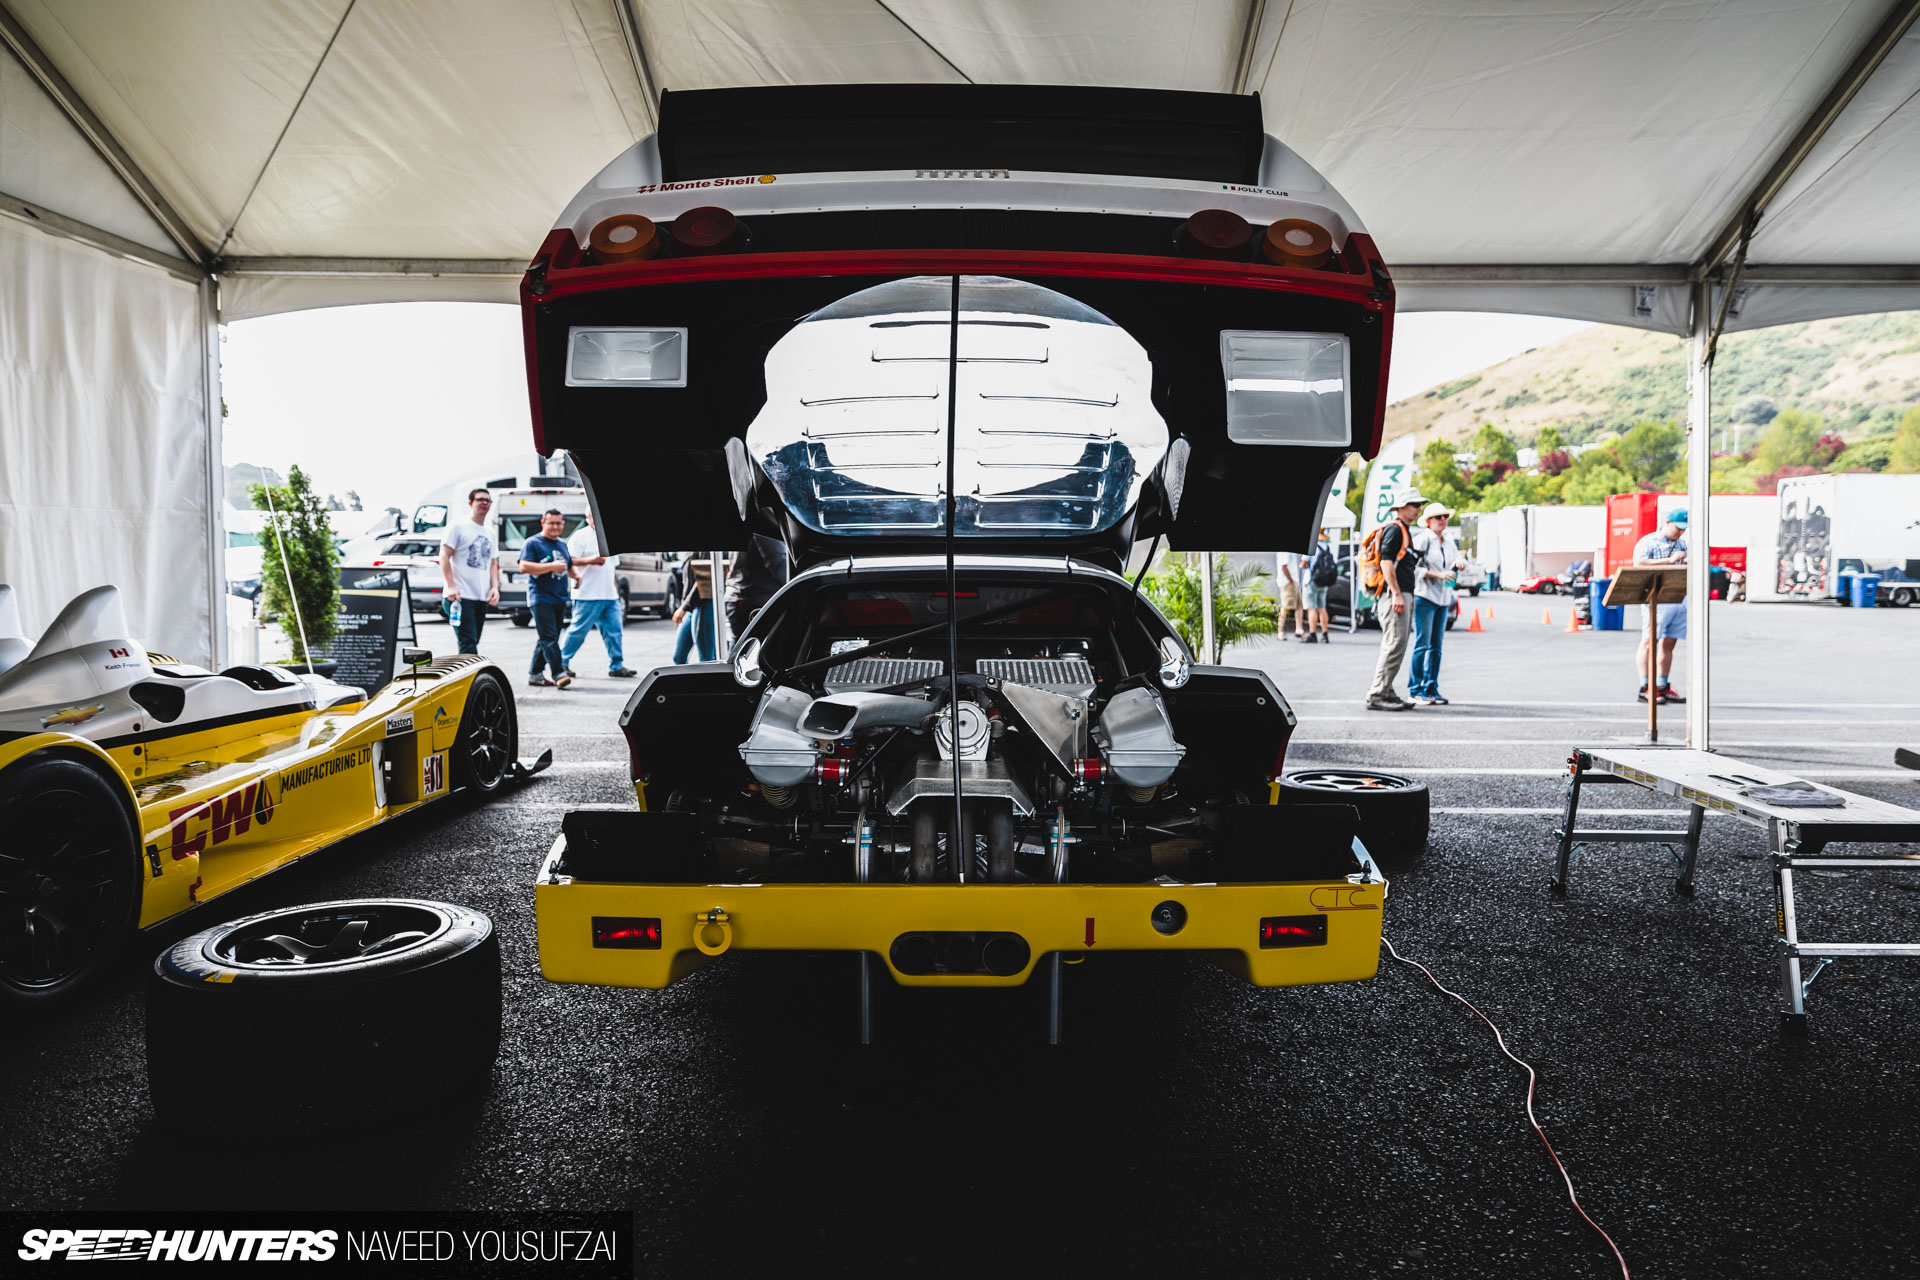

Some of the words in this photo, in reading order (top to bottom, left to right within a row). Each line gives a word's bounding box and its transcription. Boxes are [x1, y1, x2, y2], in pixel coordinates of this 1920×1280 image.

[660, 181, 711, 191] Monte
[714, 177, 755, 187] Shell
[1237, 186, 1263, 194] JOLLY
[1266, 189, 1289, 197] CLUB
[387, 717, 413, 729] Masters
[281, 750, 356, 794] MANUFACTURING
[358, 747, 371, 766] LTD
[168, 782, 258, 862] CW
